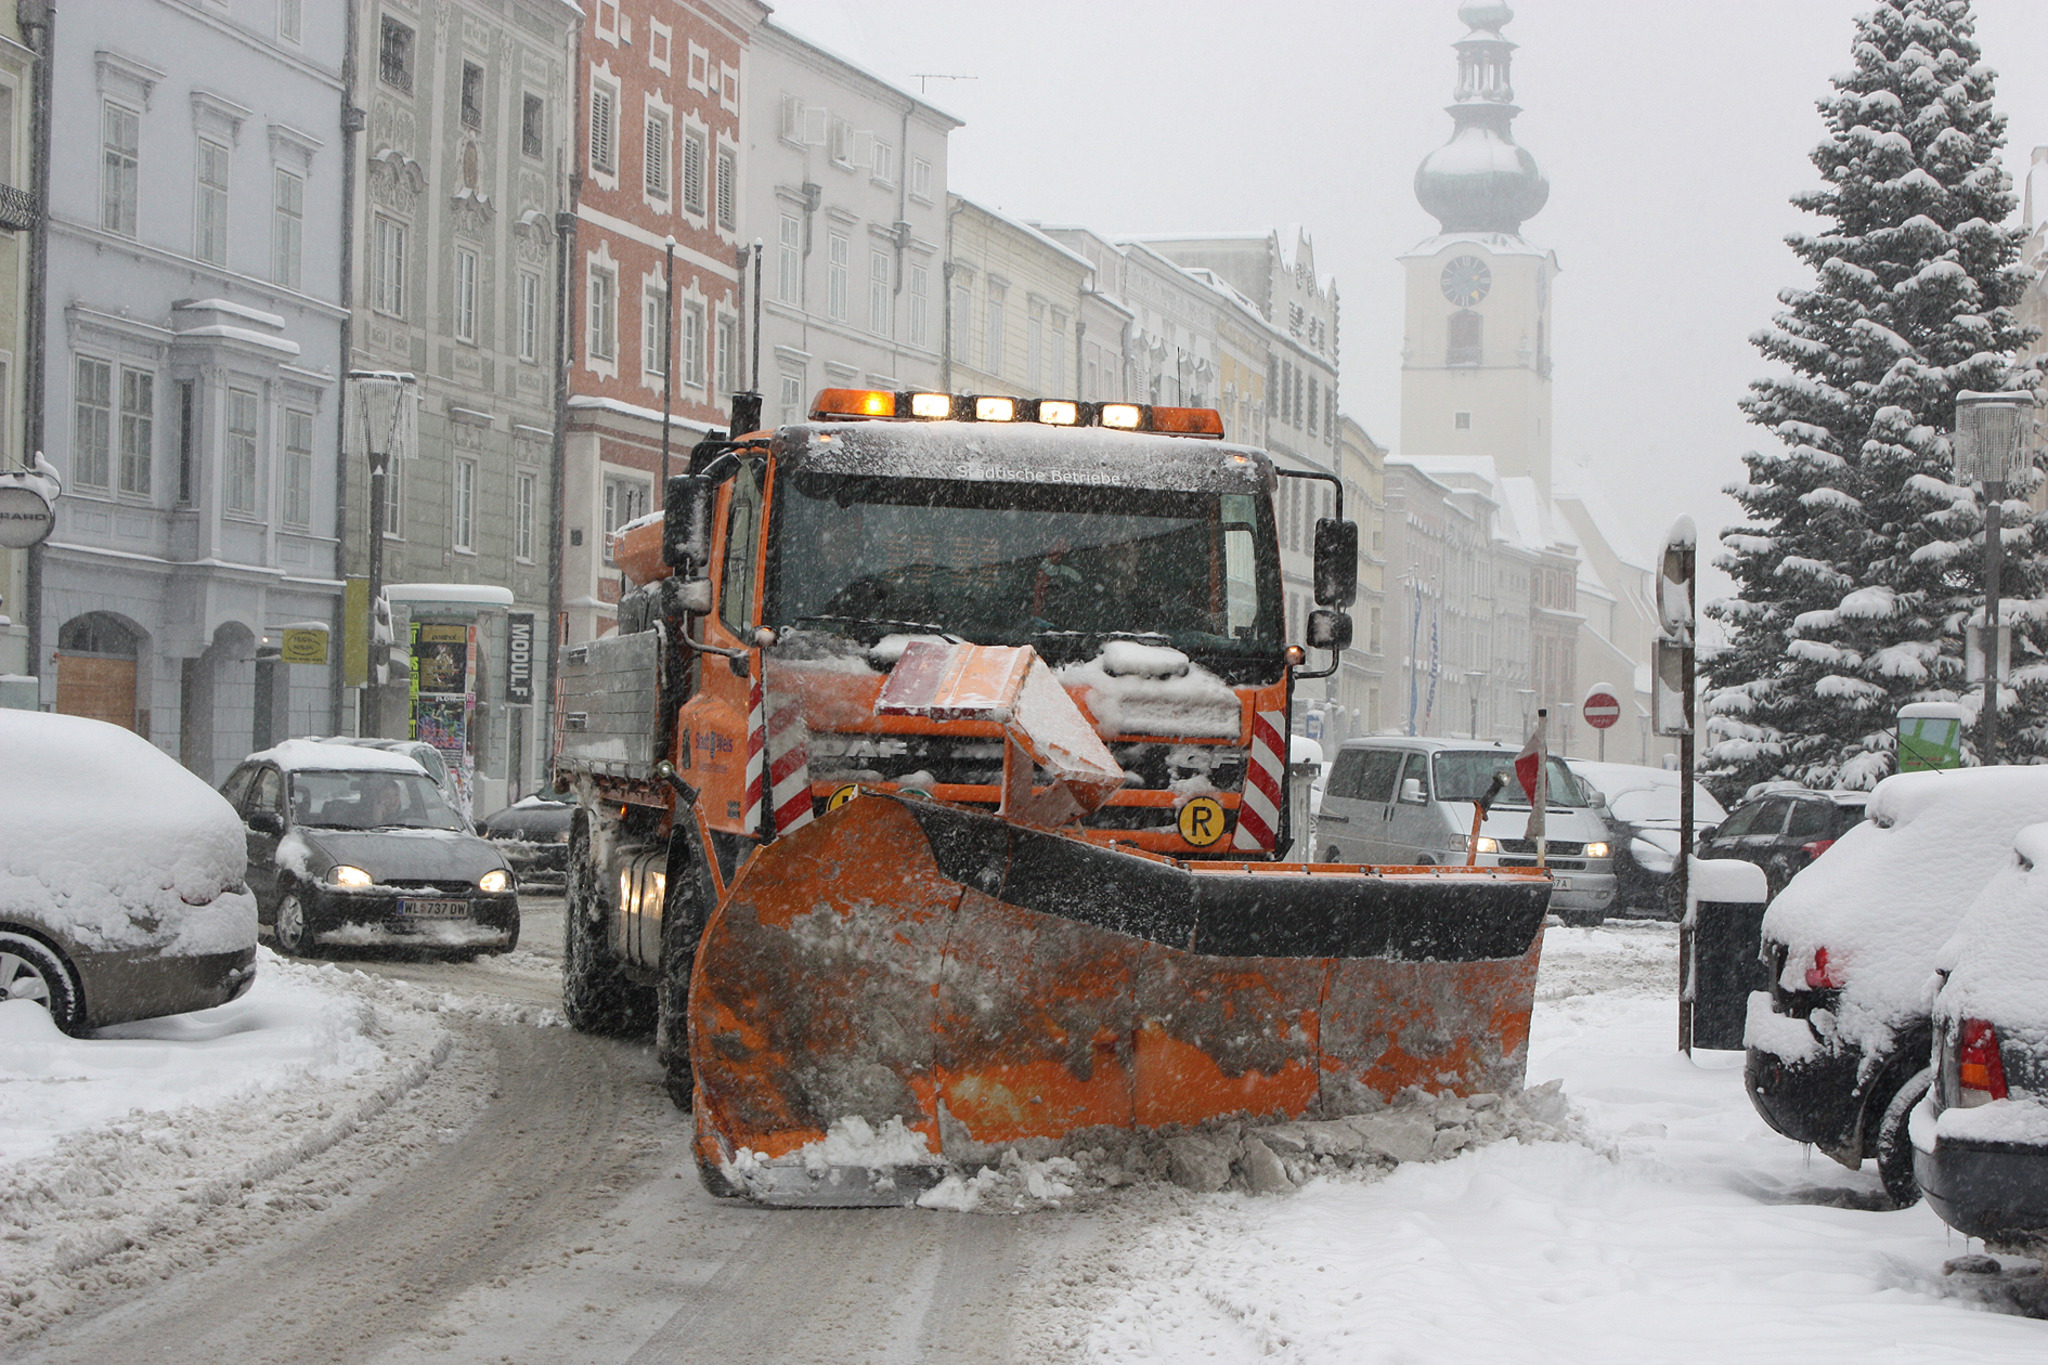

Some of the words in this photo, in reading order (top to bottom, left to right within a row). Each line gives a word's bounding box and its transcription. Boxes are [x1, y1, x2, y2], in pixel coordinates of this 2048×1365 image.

[1051, 470, 1121, 485] Betriebe
[510, 624, 530, 697] MODUL.F
[1191, 806, 1213, 837] R
[404, 902, 418, 914] WL
[427, 902, 448, 914] 737
[450, 903, 466, 915] DW
